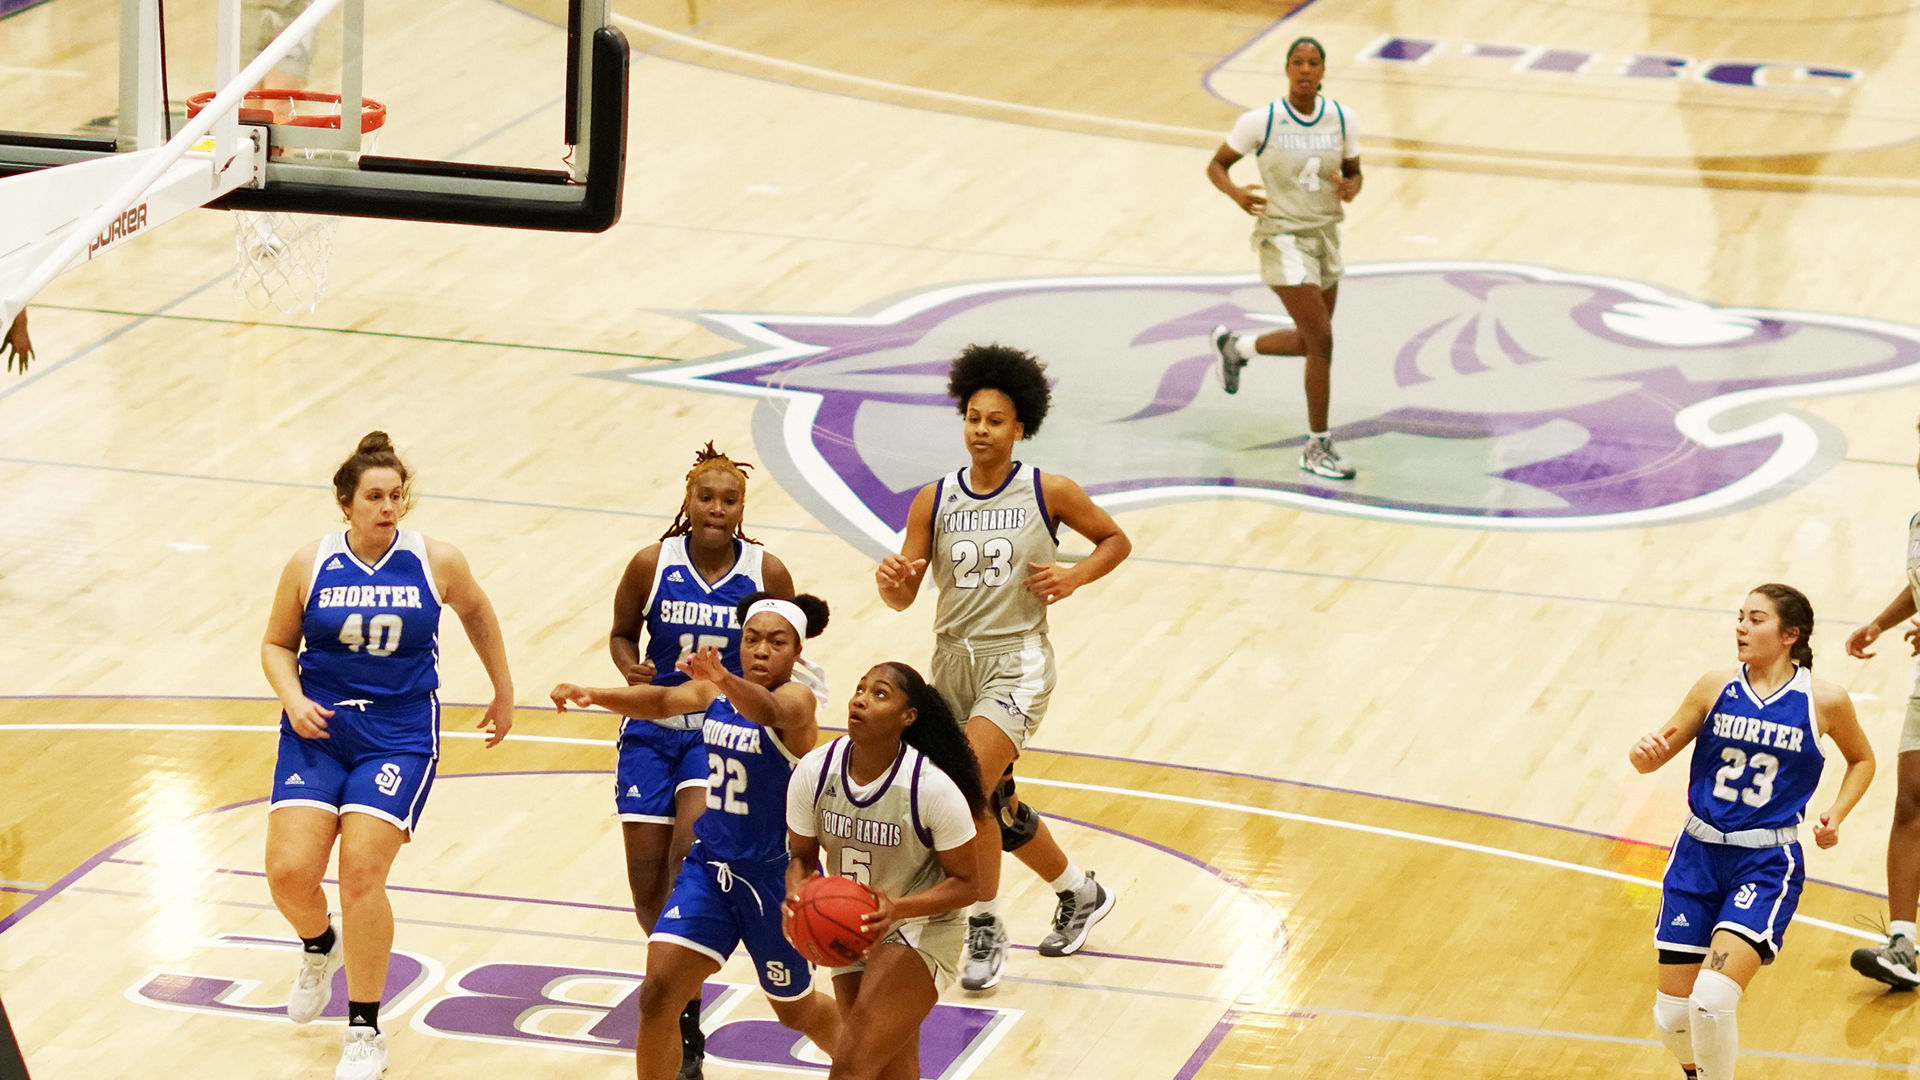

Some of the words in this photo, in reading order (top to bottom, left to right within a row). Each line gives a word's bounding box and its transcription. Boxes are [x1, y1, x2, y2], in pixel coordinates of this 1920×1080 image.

[1298, 156, 1321, 192] 4
[943, 509, 979, 533] YOUNG
[981, 507, 1027, 531] HARRIS
[951, 537, 1013, 589] 23
[318, 585, 422, 609] SHORTER
[660, 599, 742, 630] SHORTE
[338, 613, 404, 656] 40
[703, 718, 763, 754] HORTER
[1712, 712, 1804, 752] SHORTER
[706, 752, 749, 815] 22
[1712, 746, 1779, 808] 23
[855, 817, 902, 847] HARRIS
[840, 846, 872, 888] 5
